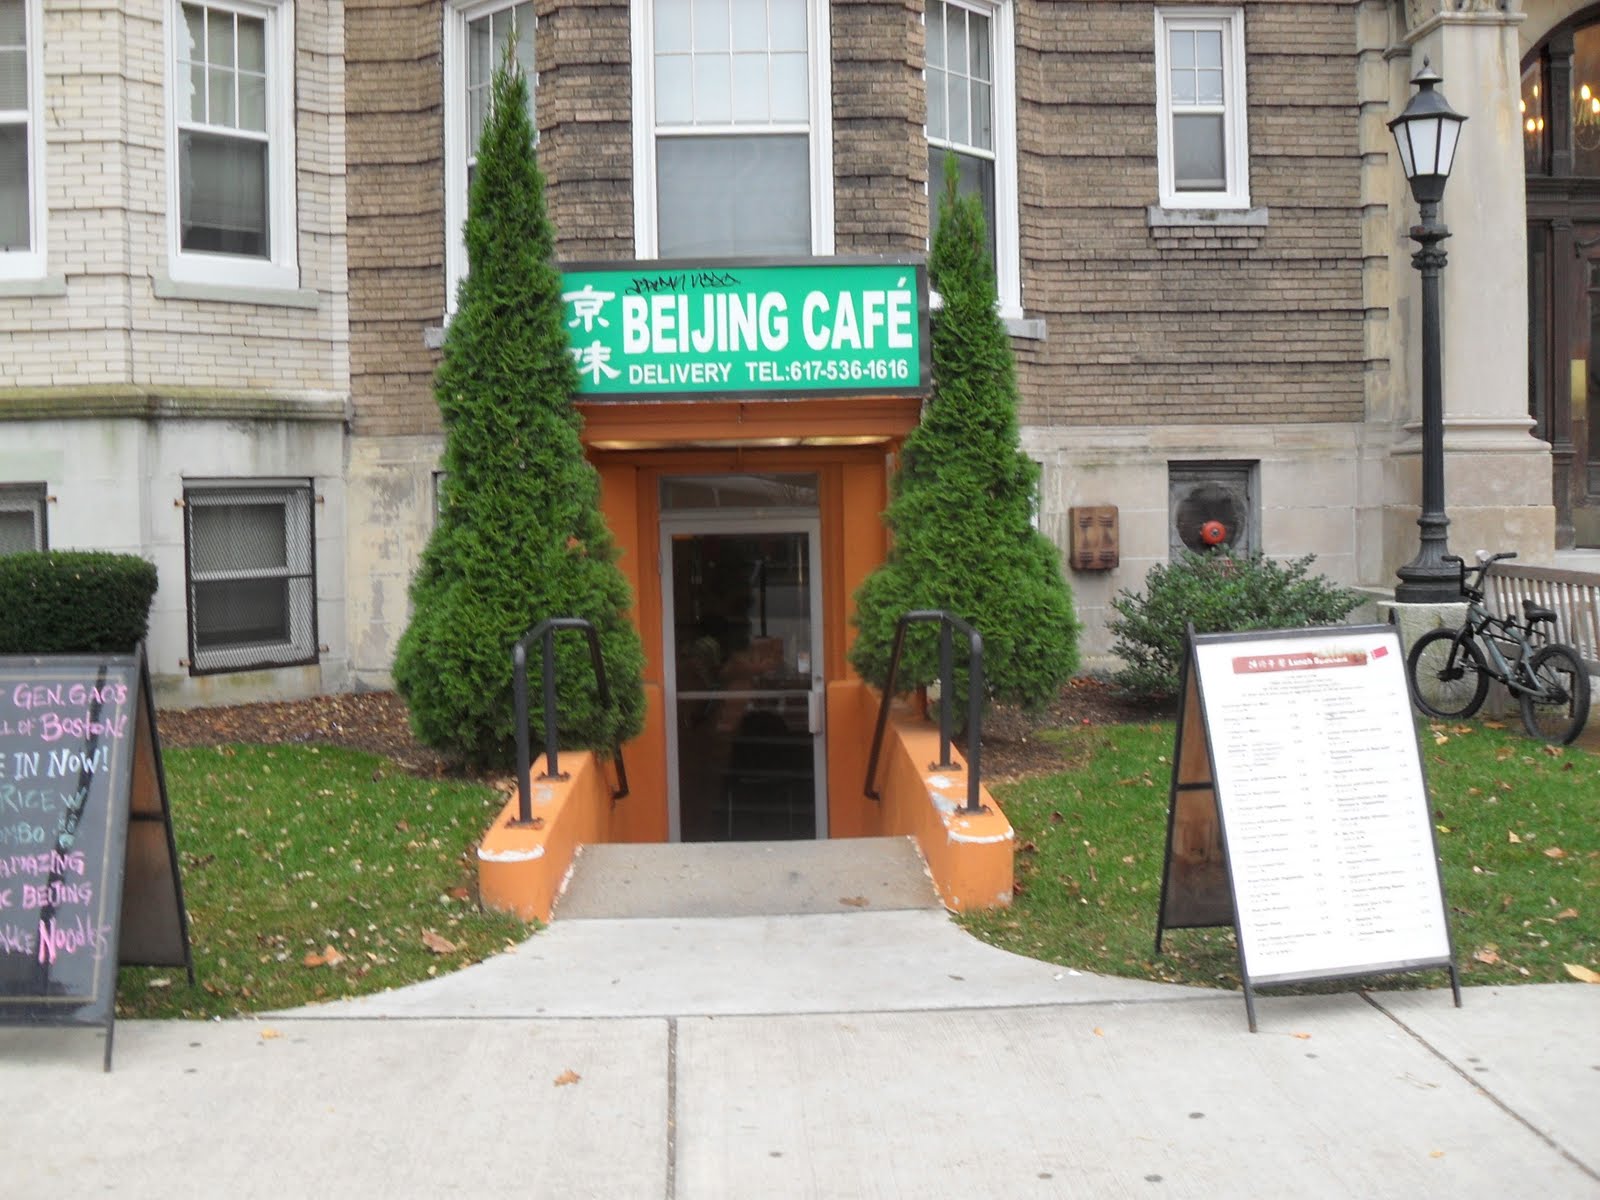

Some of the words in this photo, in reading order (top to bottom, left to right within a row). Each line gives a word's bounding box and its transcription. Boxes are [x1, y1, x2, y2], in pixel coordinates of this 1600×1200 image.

[621, 291, 790, 355] BEIJING
[802, 276, 913, 351] CAFÉ
[629, 362, 732, 385] DELIVERY
[745, 359, 909, 382] TEL:617-536-1616
[13, 751, 40, 781] IN
[22, 881, 94, 910] BEIJING
